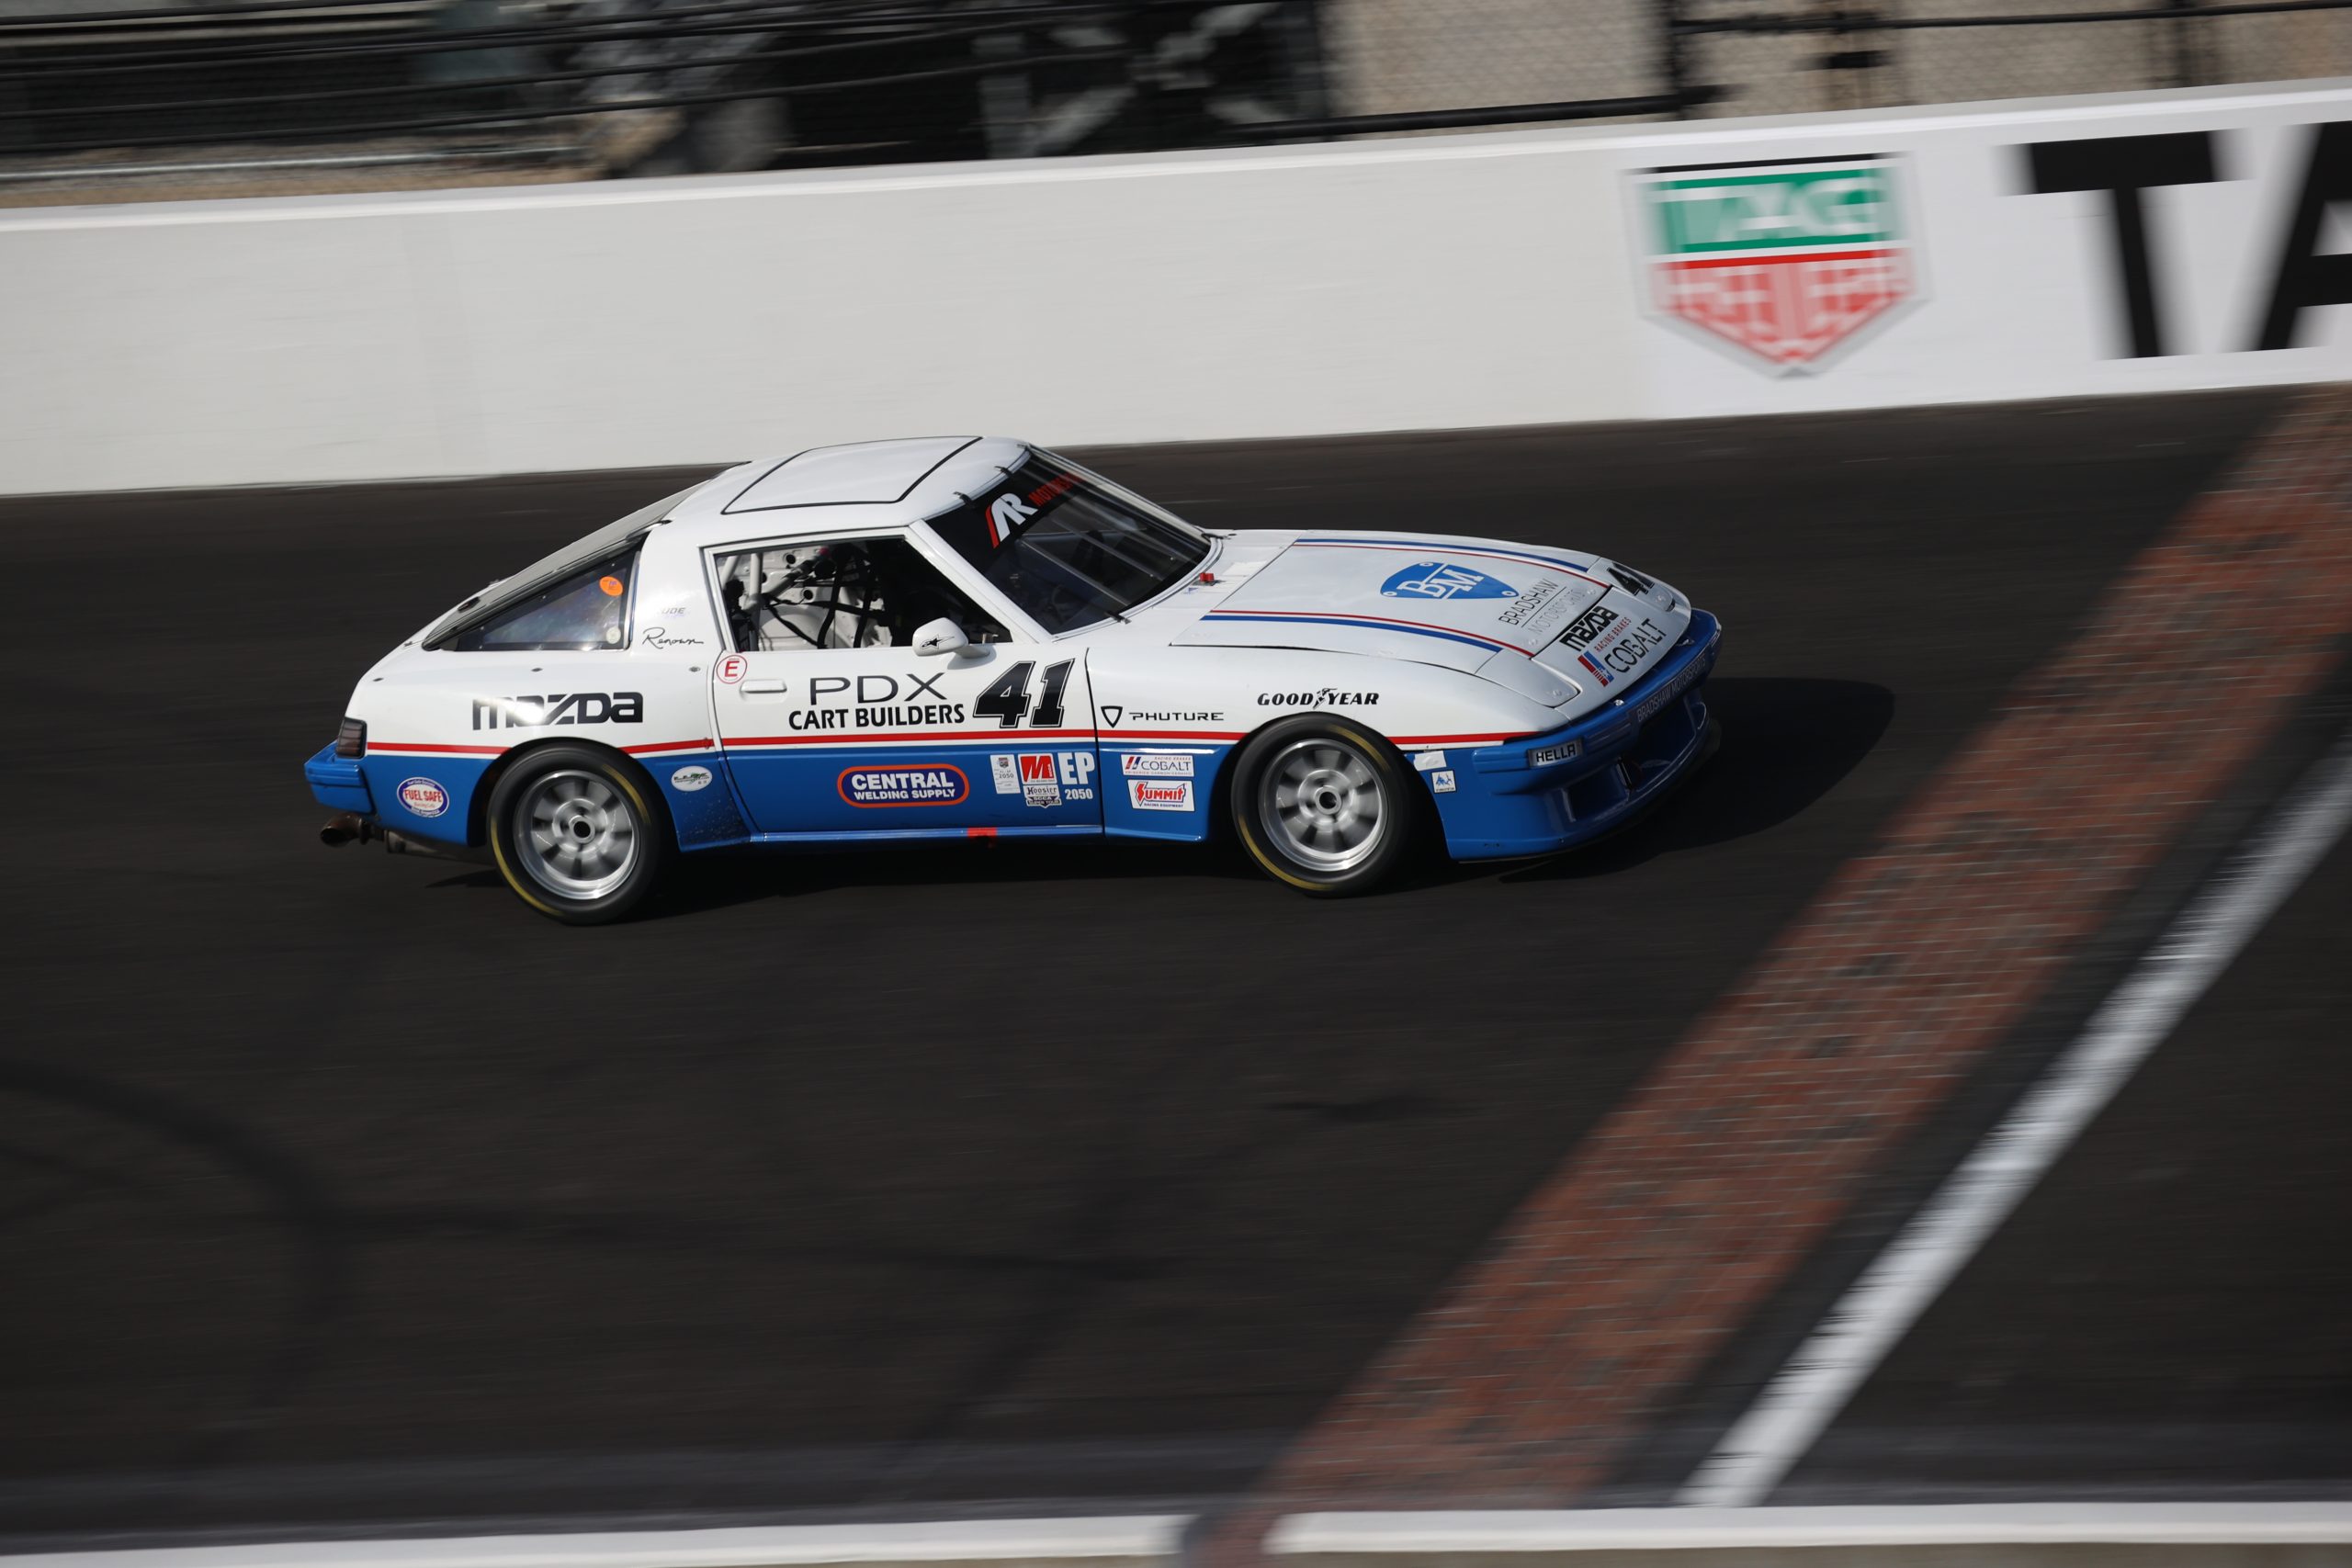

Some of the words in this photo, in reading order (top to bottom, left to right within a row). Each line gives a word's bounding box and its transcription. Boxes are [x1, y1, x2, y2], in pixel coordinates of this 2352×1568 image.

[1498, 578, 1559, 626] BRADSHAW
[1594, 633, 1614, 653] RACING
[1612, 616, 1632, 637] BRAKES
[1604, 618, 1667, 672] COBALT
[725, 660, 740, 677] E
[809, 672, 947, 705] PDX
[972, 658, 1076, 728] 41
[1637, 683, 1671, 723] BRADSHAW
[788, 708, 849, 730] CART
[855, 704, 966, 728] BUILDERS
[1128, 712, 1225, 721] PHUTURE
[1535, 742, 1577, 762] HELLA
[1057, 752, 1095, 784] EP
[1141, 761, 1191, 771] COBALT
[851, 769, 954, 790] CENTRAL
[404, 790, 423, 801] FUEL
[424, 791, 442, 802] SAFE
[854, 790, 909, 801] WELDING
[911, 787, 956, 801] SUPPLY
[1065, 789, 1093, 800] 2050
